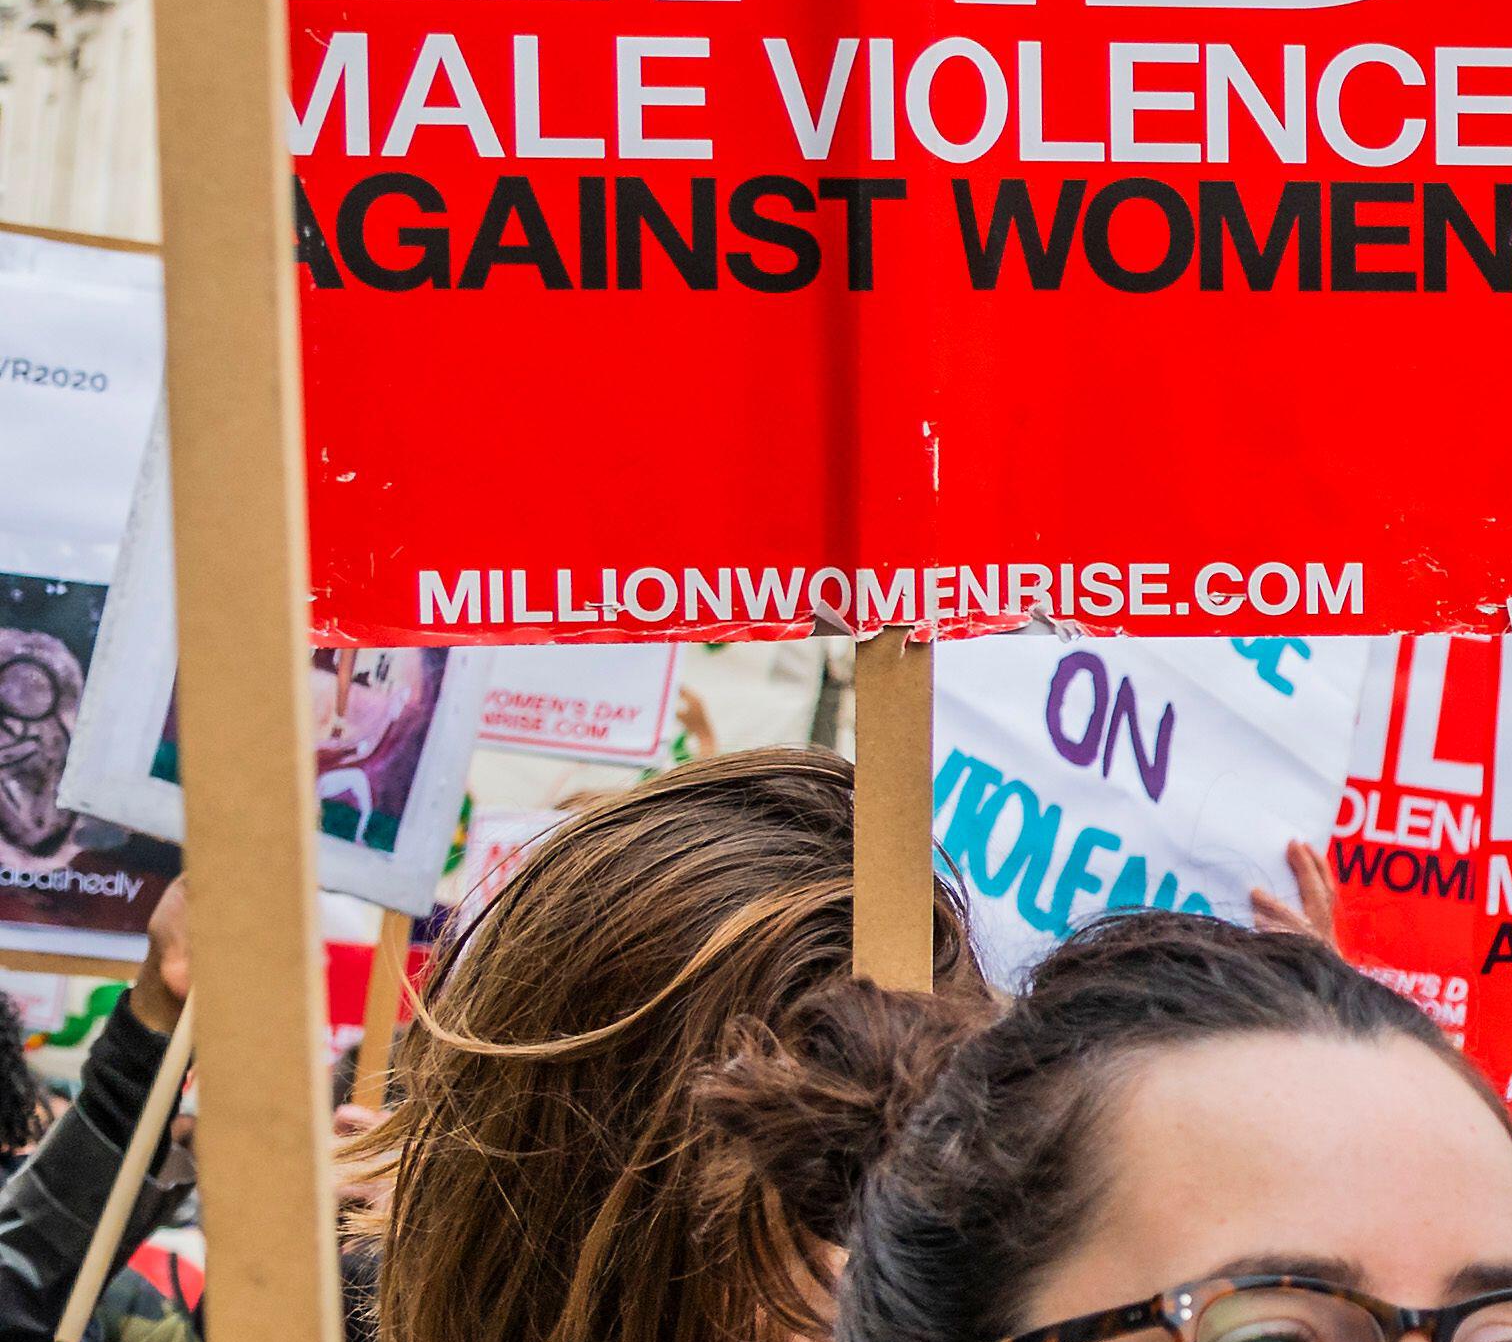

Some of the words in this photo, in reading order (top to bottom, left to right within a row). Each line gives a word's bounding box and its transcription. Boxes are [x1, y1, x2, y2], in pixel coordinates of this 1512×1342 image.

[284, 31, 714, 161] MALE
[419, 562, 1366, 626] MILLIONWOMENRISE.COM
[1046, 650, 1175, 804] ON
[1335, 841, 1475, 901] WOM
